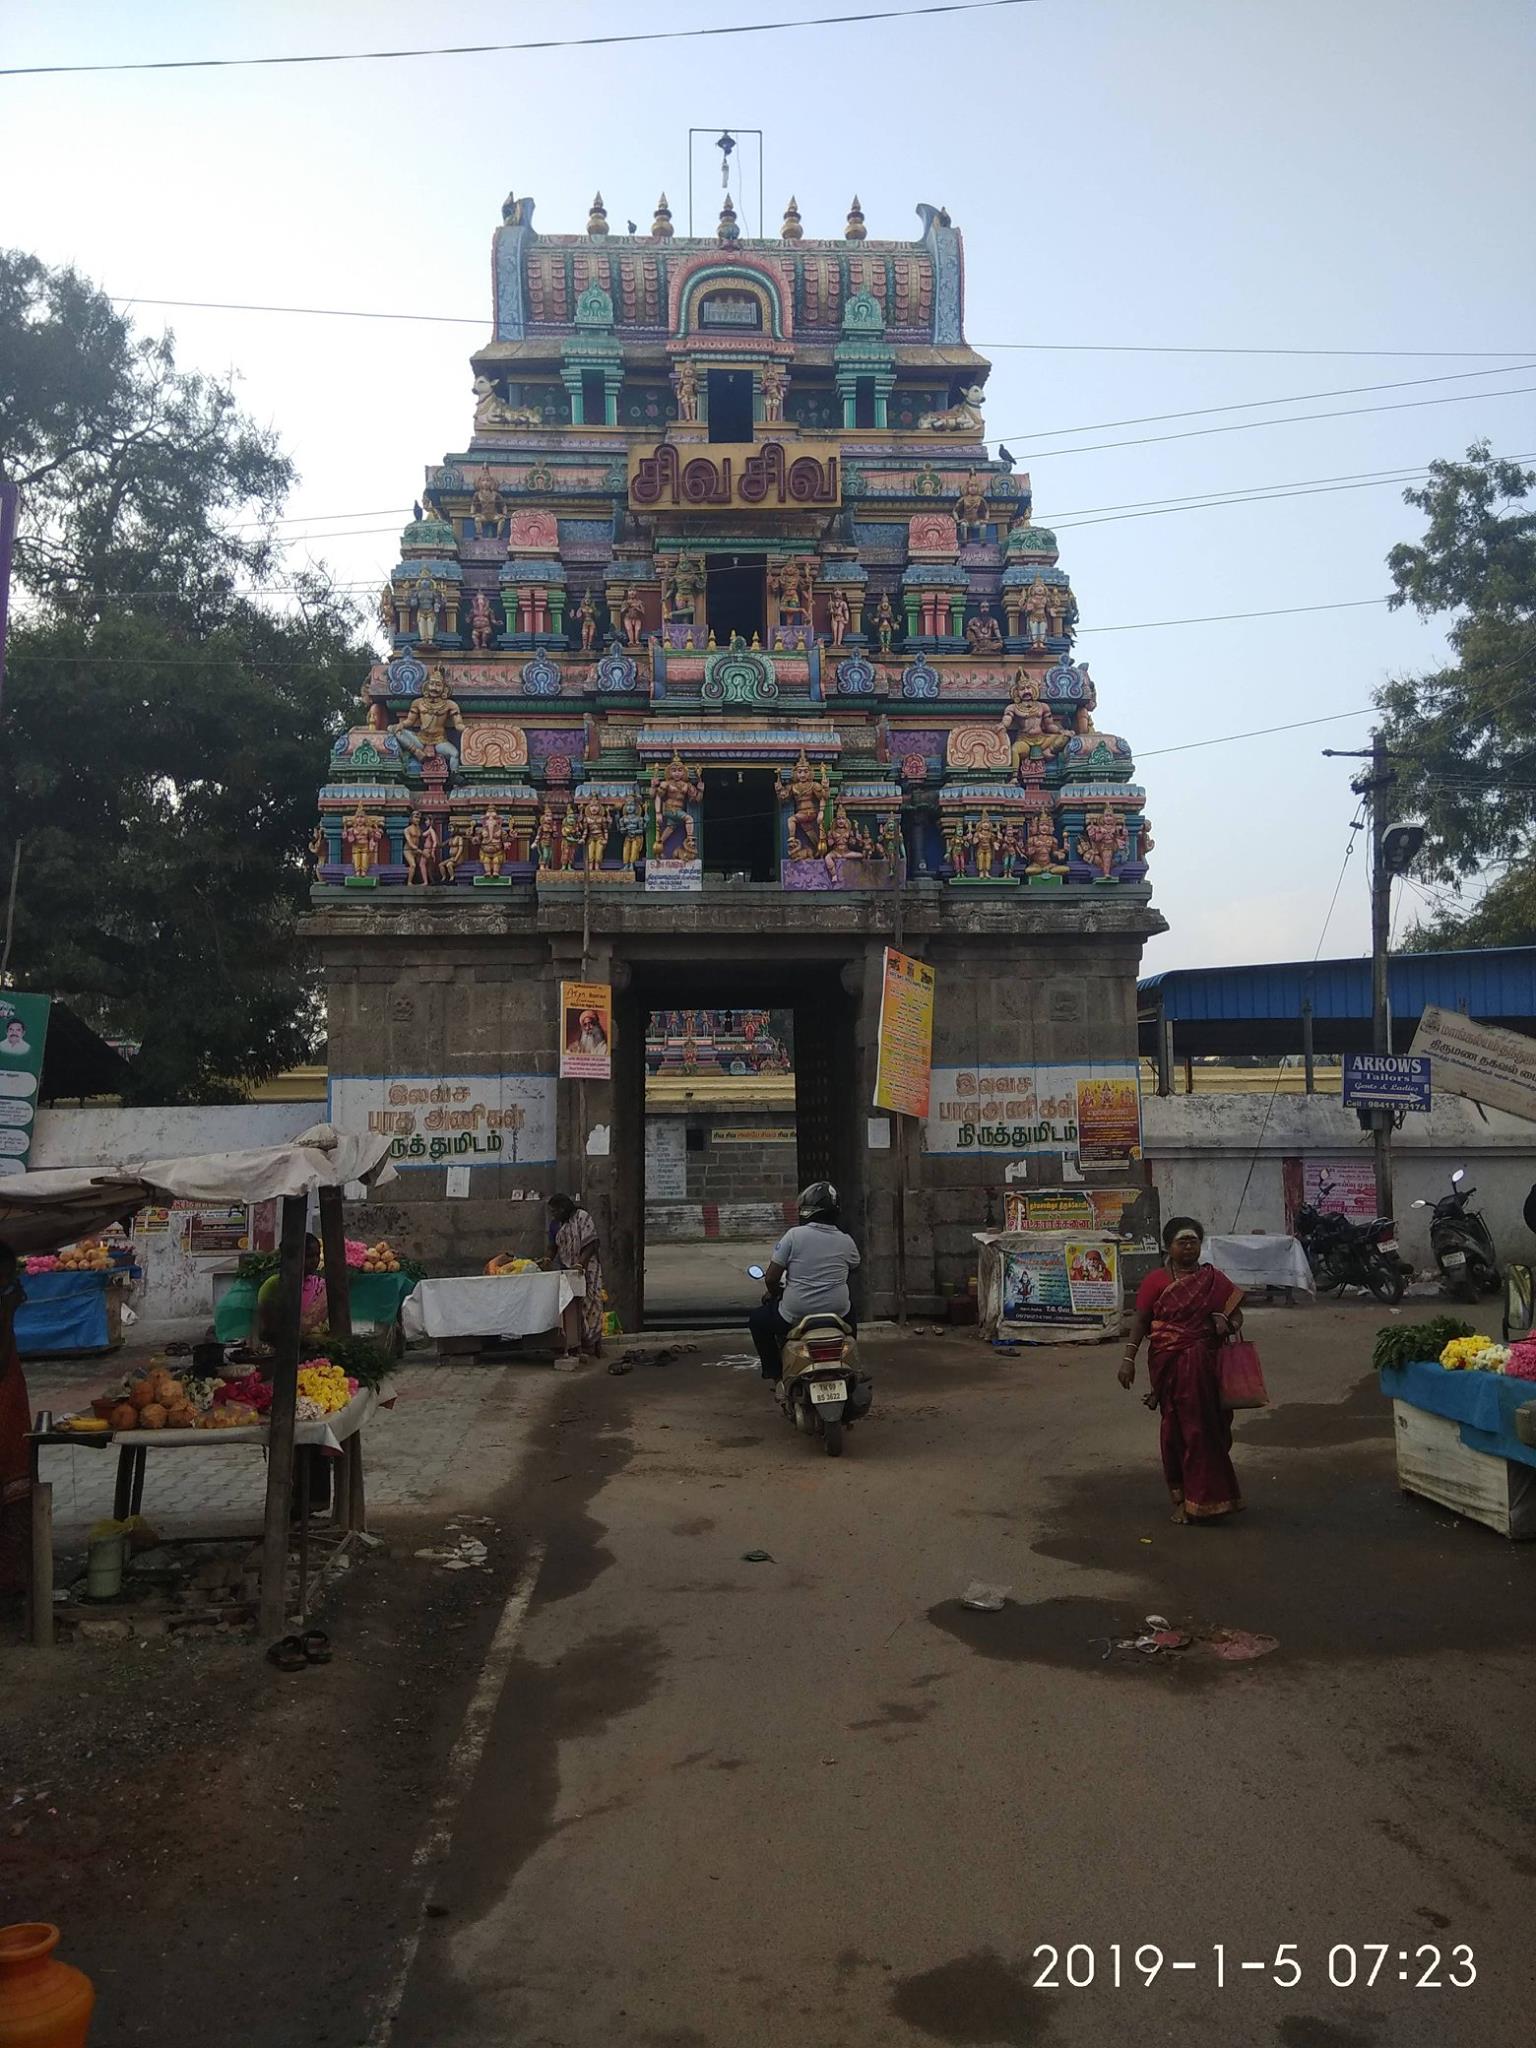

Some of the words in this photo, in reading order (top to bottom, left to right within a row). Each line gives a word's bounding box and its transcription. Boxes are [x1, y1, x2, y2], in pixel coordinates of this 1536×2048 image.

[631, 443, 732, 505] சிவ
[738, 442, 839, 503] சிவ
[1352, 1056, 1422, 1074] ARROWS
[1364, 1072, 1410, 1082] Tailors
[388, 1083, 471, 1107] இலவச
[956, 1072, 1033, 1097] இலவச
[1354, 1082, 1378, 1090] Gents
[1390, 1084, 1419, 1092] Ladies
[368, 1110, 417, 1136] பாத
[424, 1102, 526, 1131] அணிகள்
[389, 1130, 505, 1161] ருத்துமிடம்
